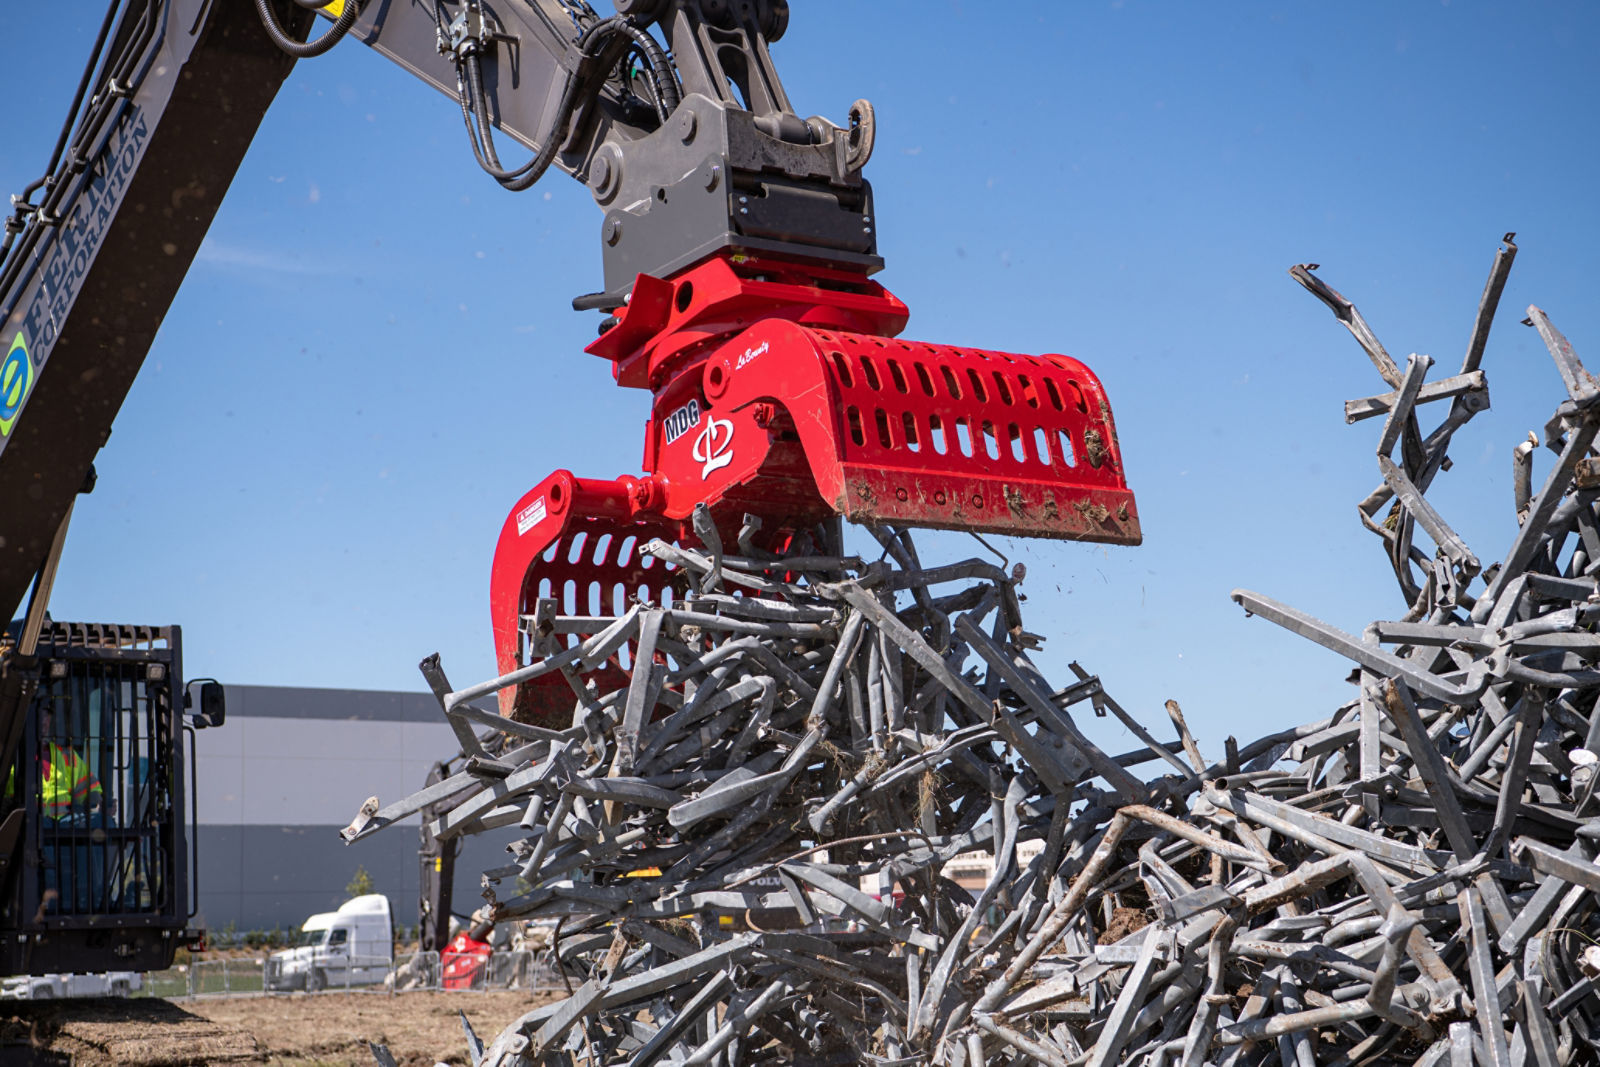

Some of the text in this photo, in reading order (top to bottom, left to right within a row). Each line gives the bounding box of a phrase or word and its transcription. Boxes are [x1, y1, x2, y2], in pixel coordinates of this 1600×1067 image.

[33, 112, 148, 366] CORPORATION
[664, 399, 699, 444] MDG
[748, 876, 784, 886] VOLV
